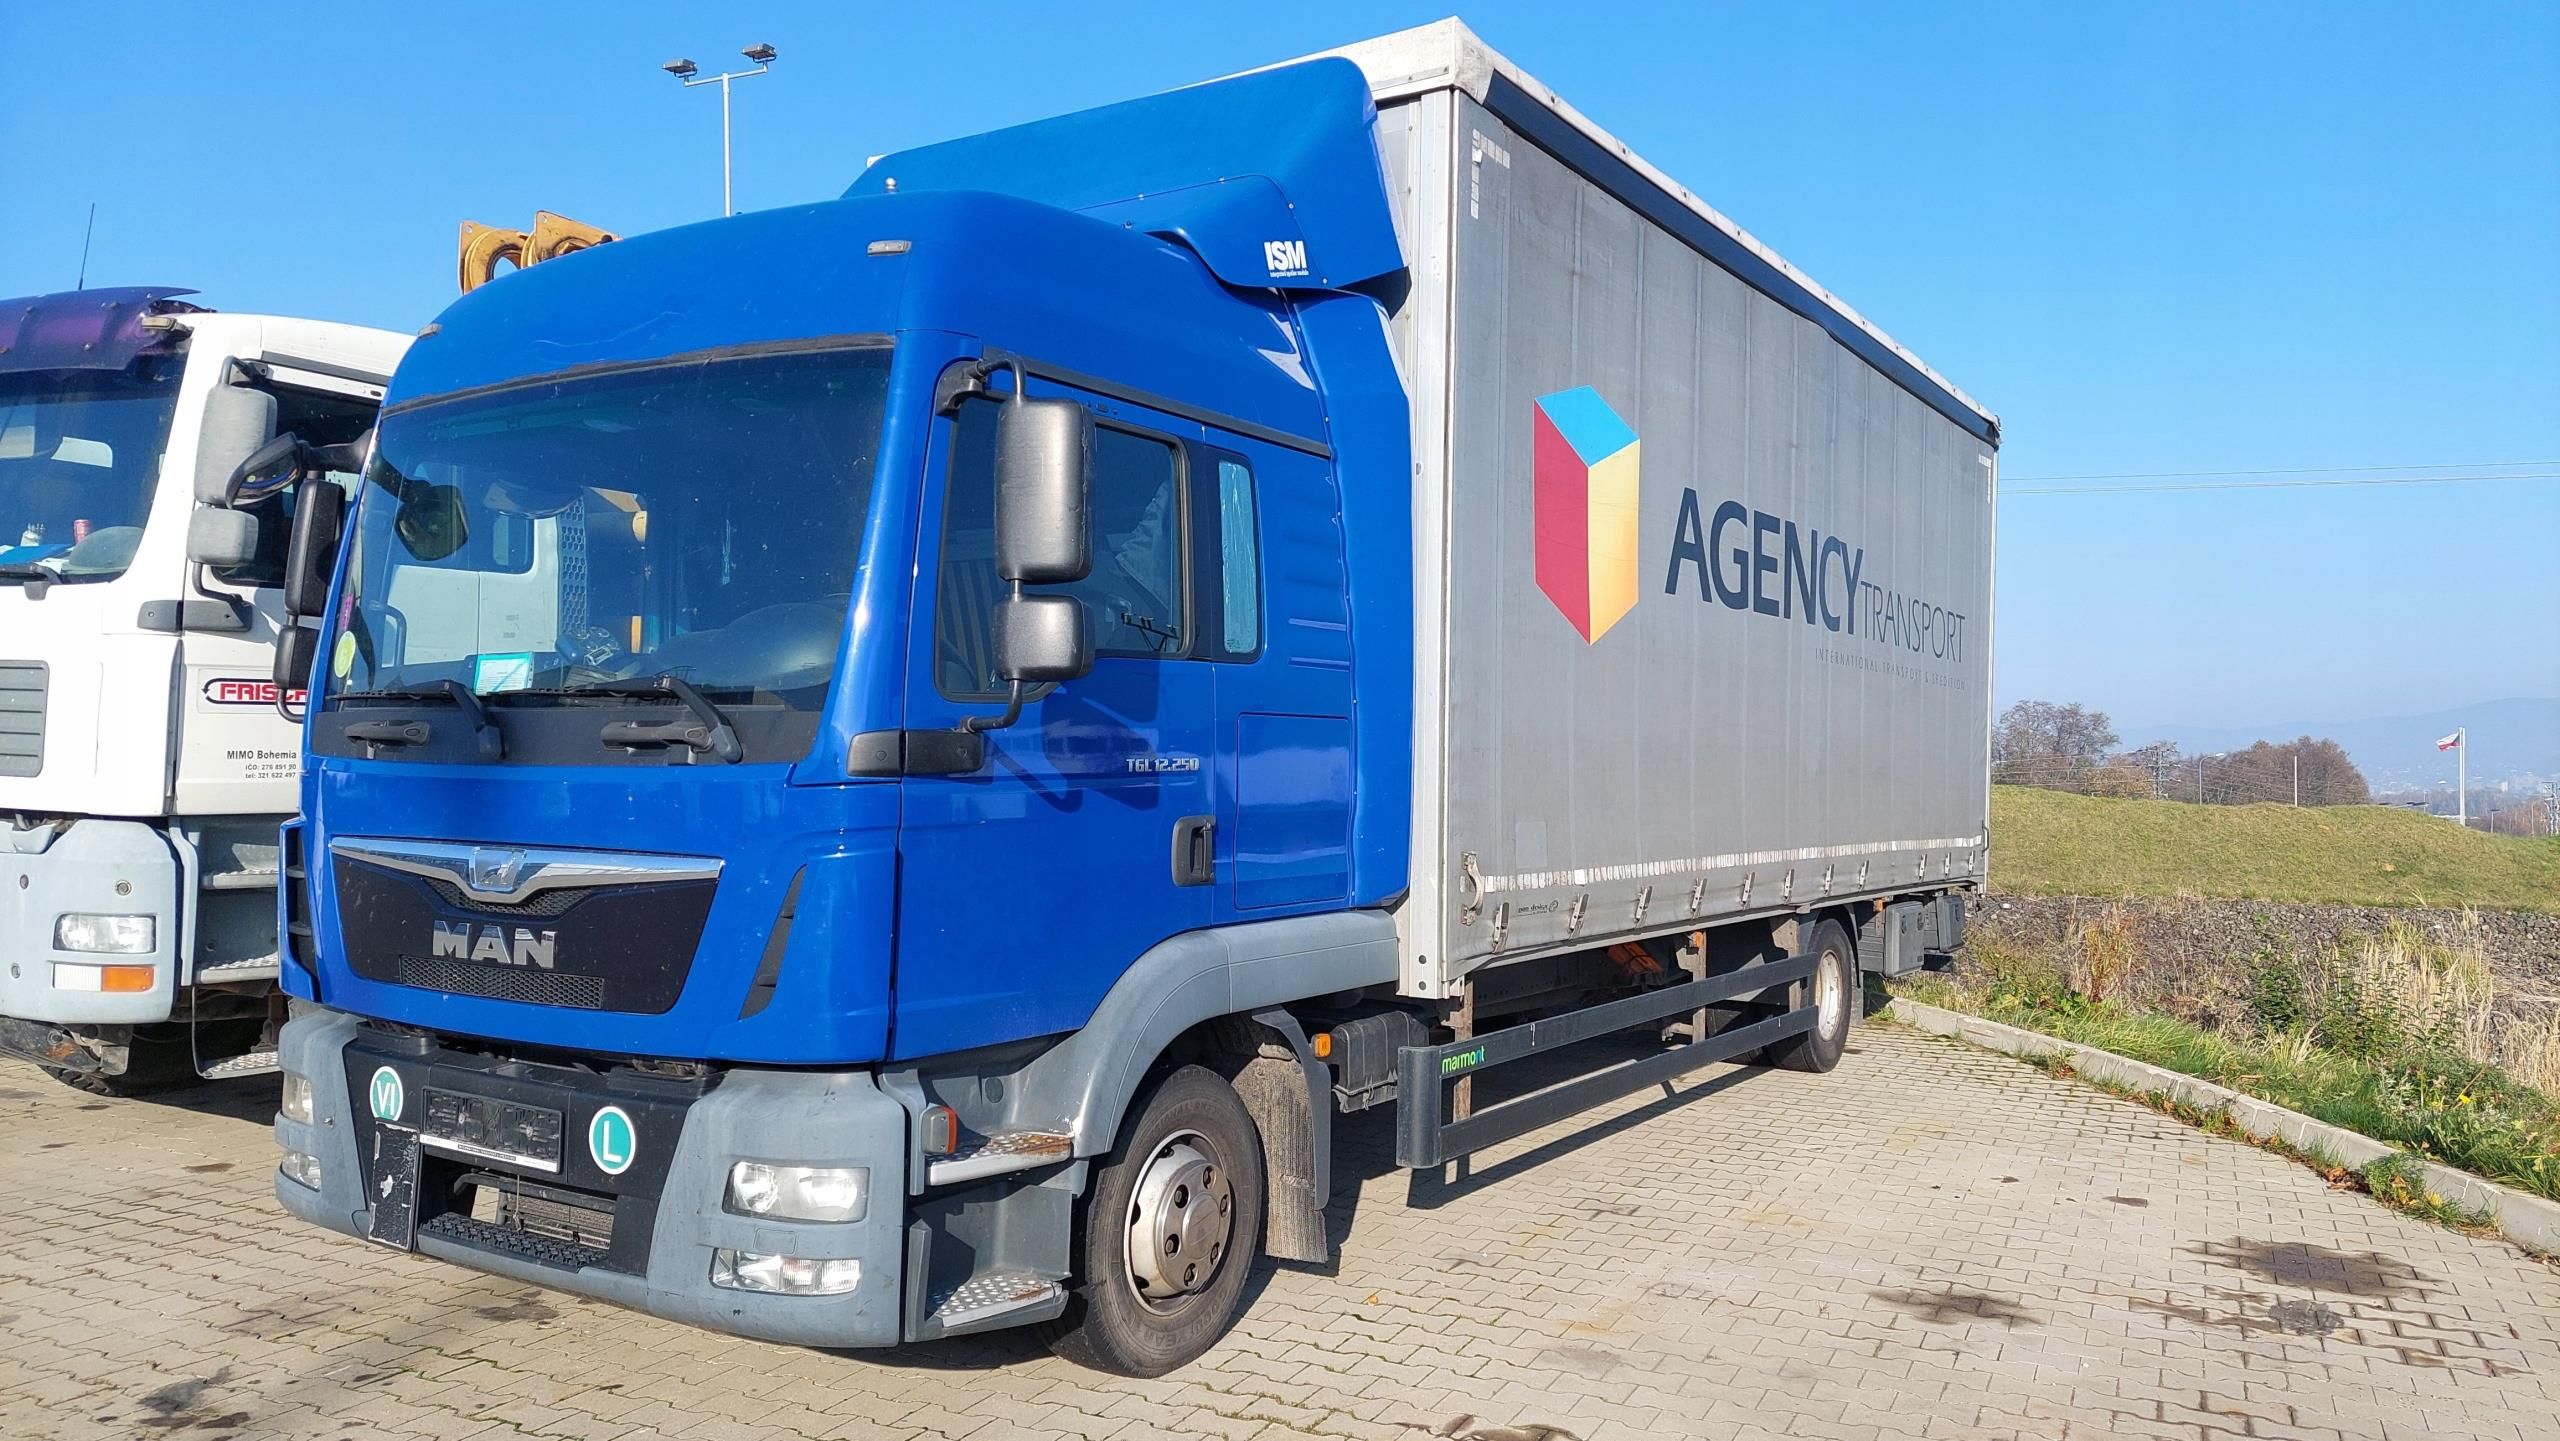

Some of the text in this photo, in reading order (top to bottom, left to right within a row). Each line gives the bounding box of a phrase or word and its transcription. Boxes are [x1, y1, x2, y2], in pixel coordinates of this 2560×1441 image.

[1264, 241, 1307, 271] ISM
[1664, 487, 1965, 663] AGENCY TRANSPORT
[1815, 648, 1878, 672] INTERNATIONAL
[1882, 662, 1922, 681] TRANSPORT
[220, 683, 307, 701] FRIS
[227, 750, 297, 760] MIMO Bohemia
[1126, 758, 1200, 773] TGL 12.250
[433, 920, 557, 969] MAN
[1442, 1046, 1485, 1073] marmont
[376, 1080, 396, 1116] VI
[603, 1120, 623, 1163] L
